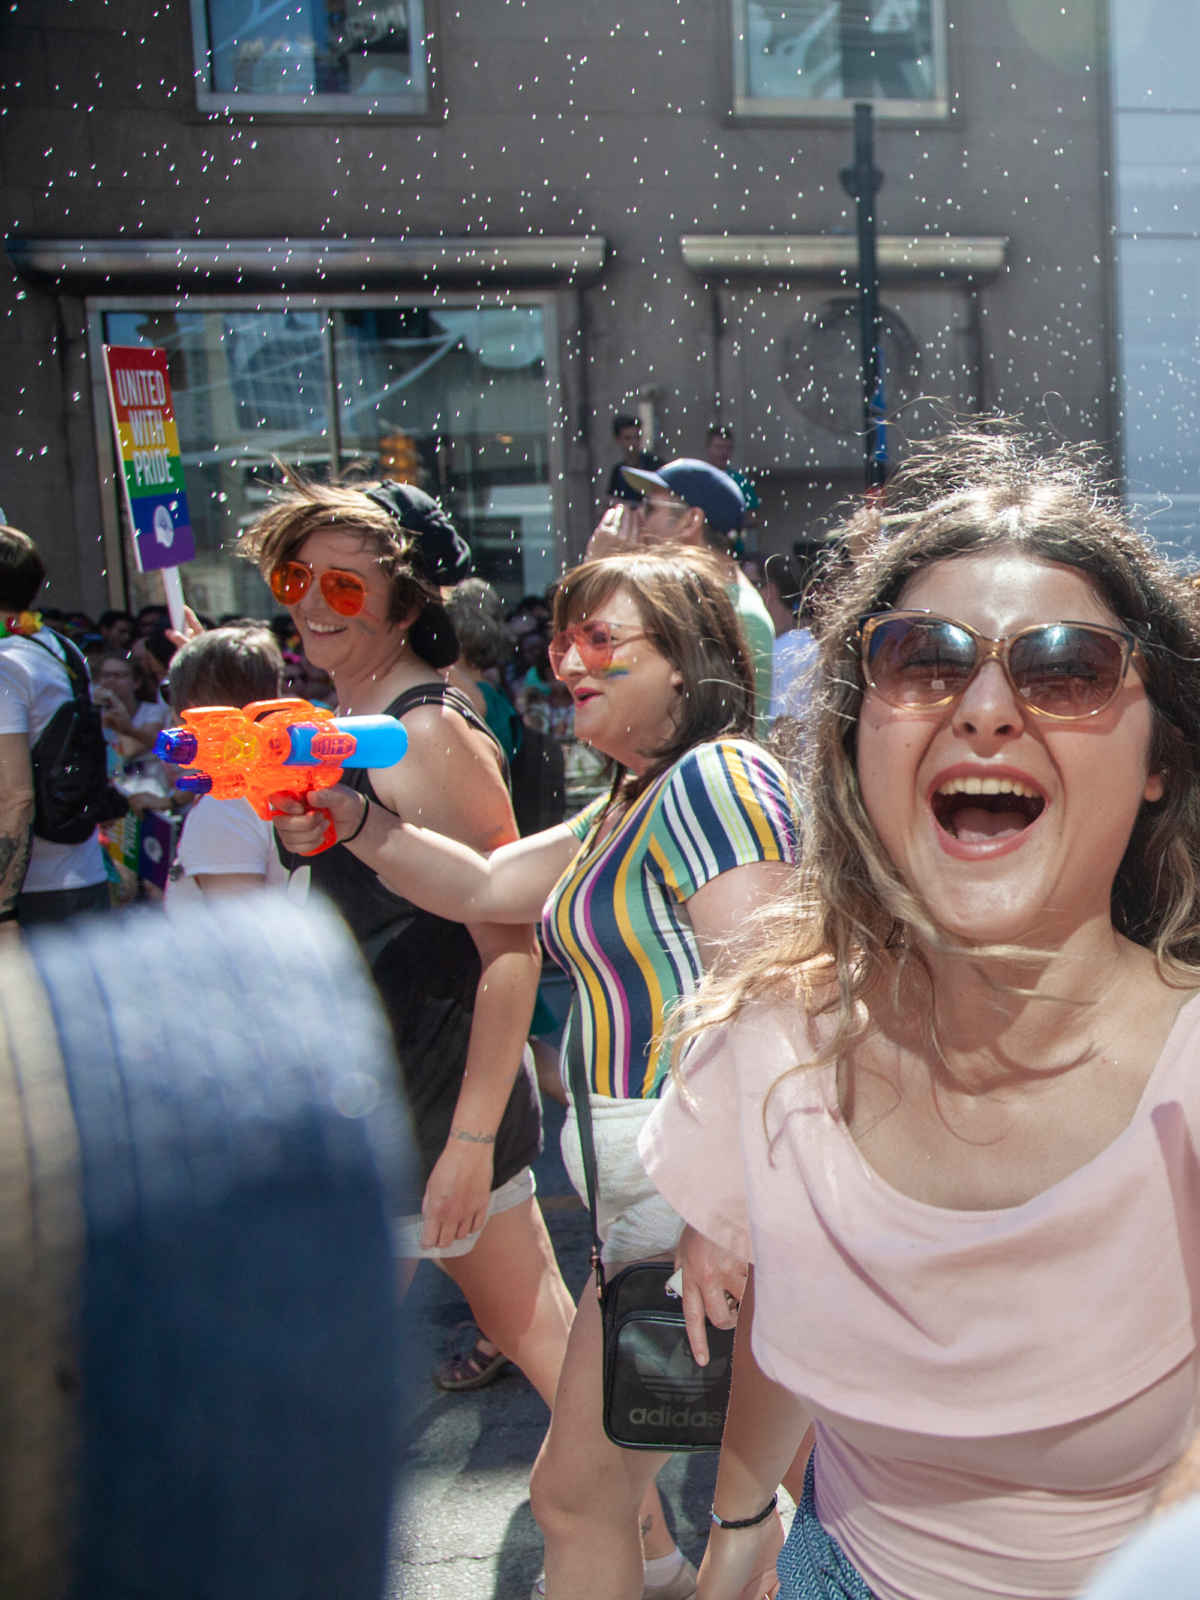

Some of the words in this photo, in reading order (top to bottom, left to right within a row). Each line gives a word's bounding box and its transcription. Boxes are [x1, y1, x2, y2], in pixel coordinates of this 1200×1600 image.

[115, 369, 165, 406] UNITED
[128, 409, 166, 446] WITH
[133, 449, 174, 486] PRIDE
[629, 1404, 722, 1426] adidas
